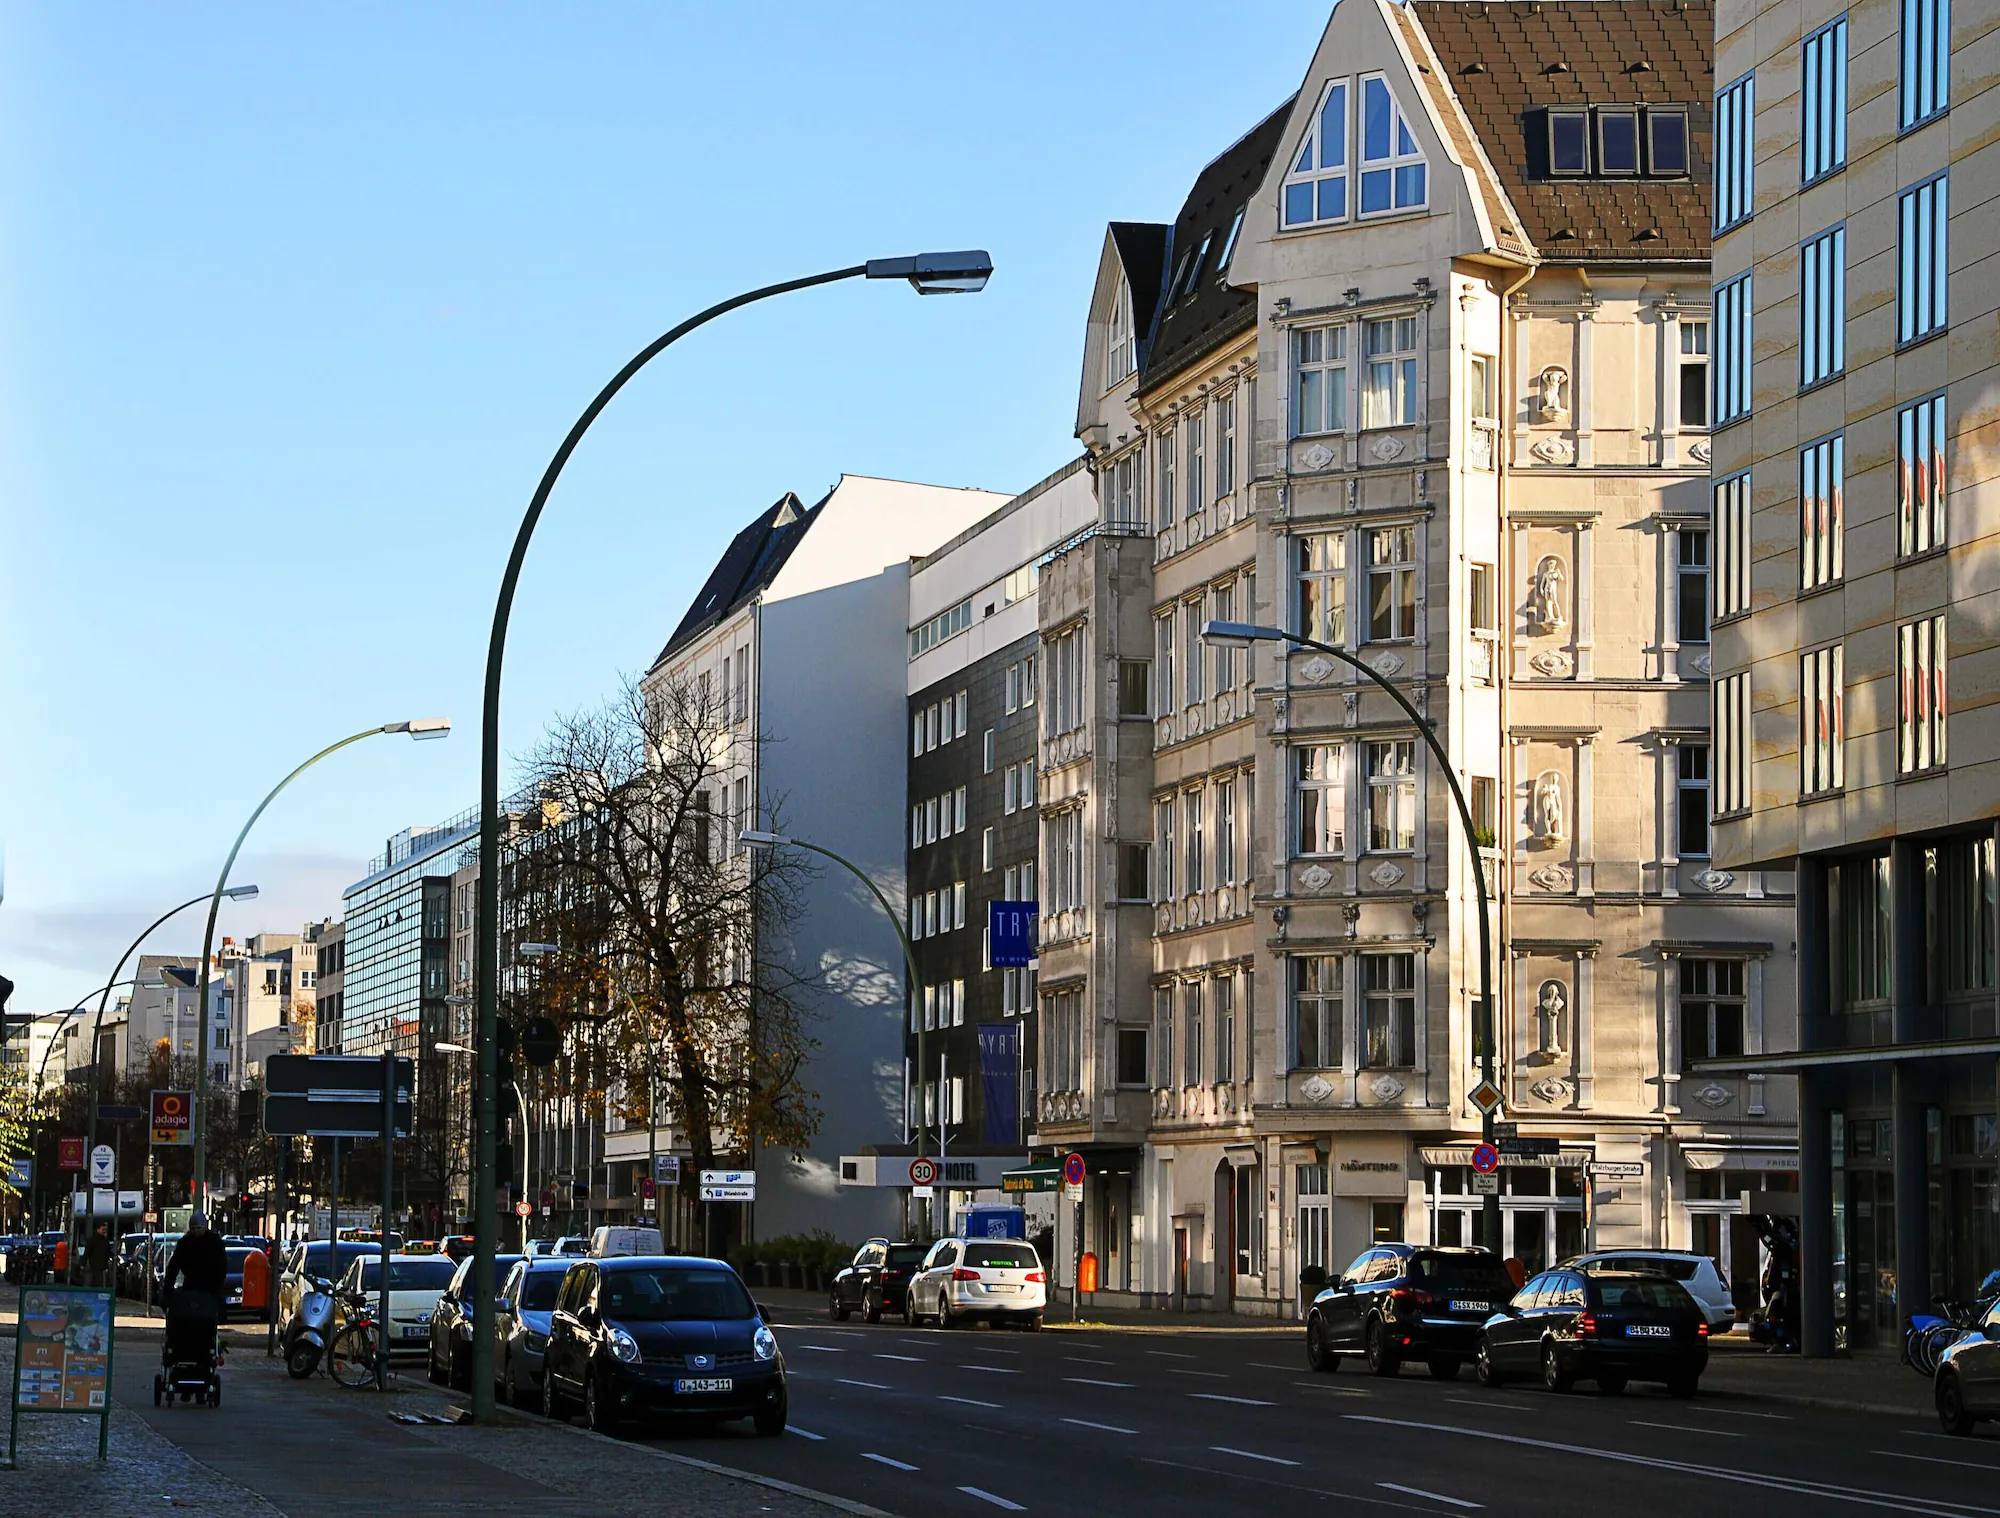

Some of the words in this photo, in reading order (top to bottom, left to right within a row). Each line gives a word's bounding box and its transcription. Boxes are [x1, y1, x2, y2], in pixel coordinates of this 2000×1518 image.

[155, 1114, 187, 1127] adagio
[915, 1166, 930, 1178] 30
[946, 1163, 975, 1180] HOTEL
[988, 1221, 1006, 1233] DIXI
